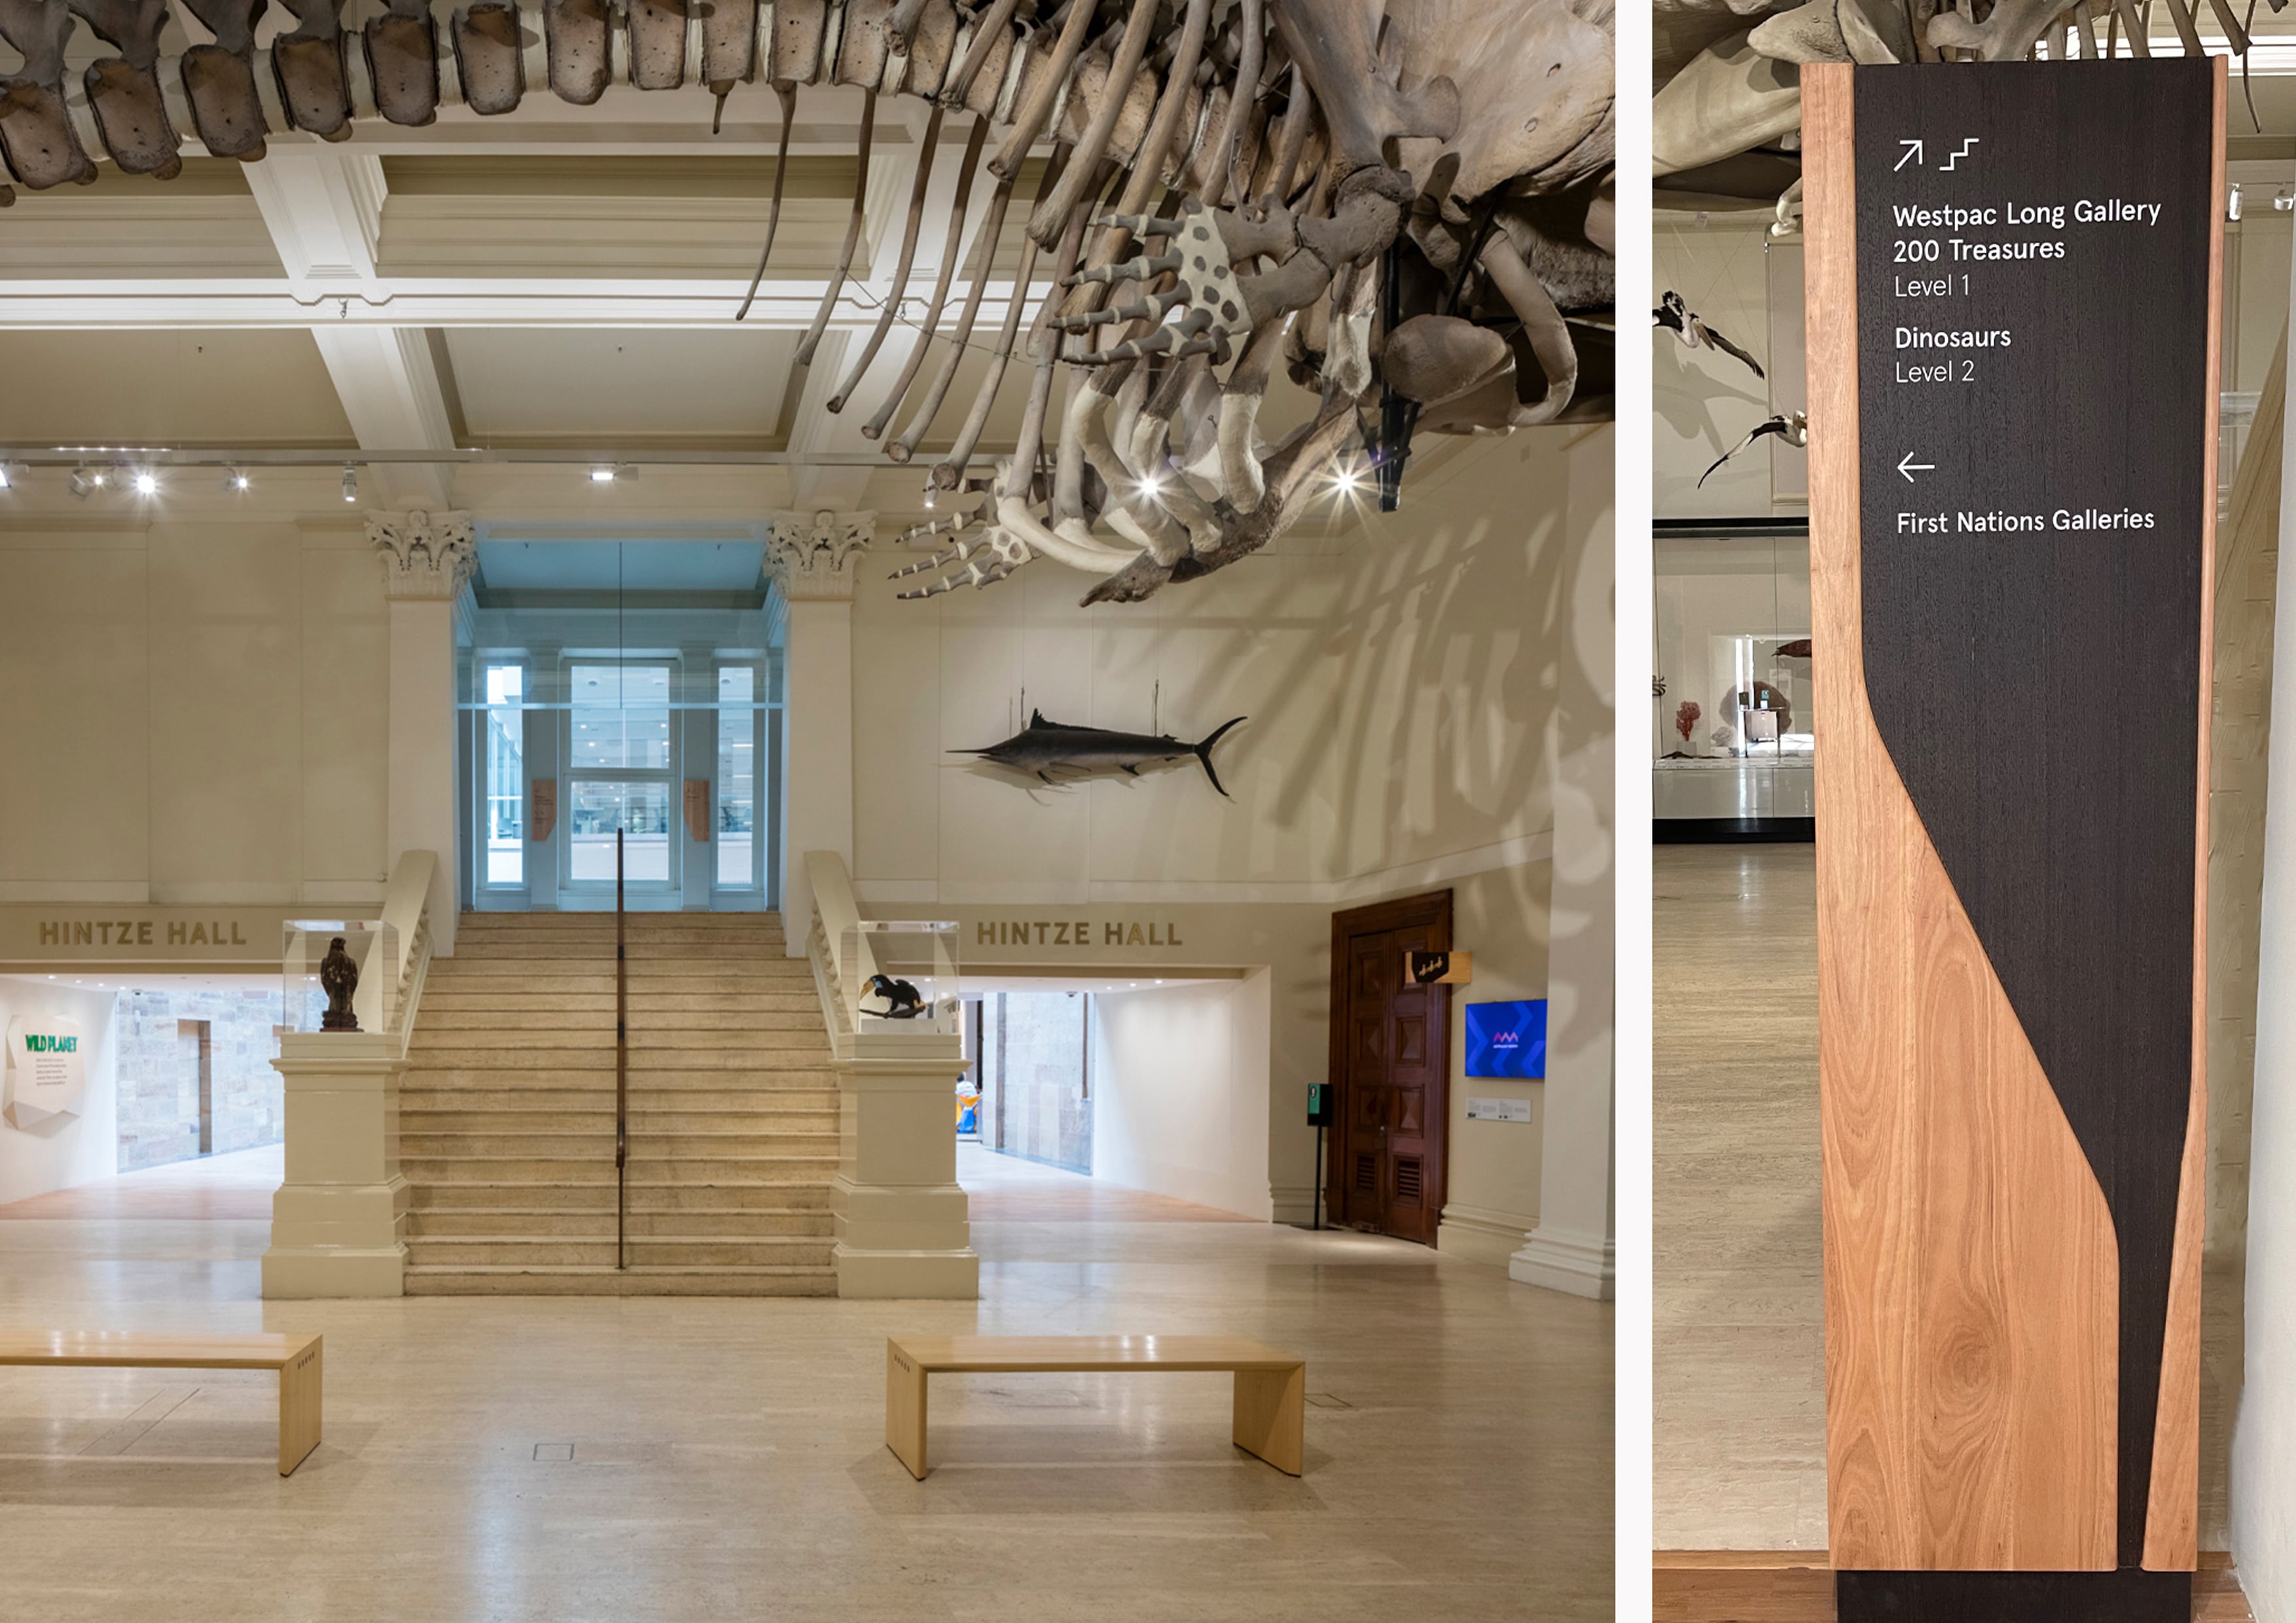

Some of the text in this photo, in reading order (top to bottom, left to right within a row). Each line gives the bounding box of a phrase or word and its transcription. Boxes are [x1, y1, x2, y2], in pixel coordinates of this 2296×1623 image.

[1892, 198, 2162, 231] Westpac Long Gallery
[1893, 238, 2066, 262] 200 Treasures
[1894, 274, 1969, 297] Level 1
[1895, 327, 2011, 349] Dinosaurs
[1895, 359, 1975, 383] Level 2
[1897, 507, 2155, 534] First Nations Galleries
[40, 921, 247, 946] HINTZE HALL
[977, 921, 1183, 946] HINTZE HALL
[25, 1034, 78, 1053] WILD PLANET
